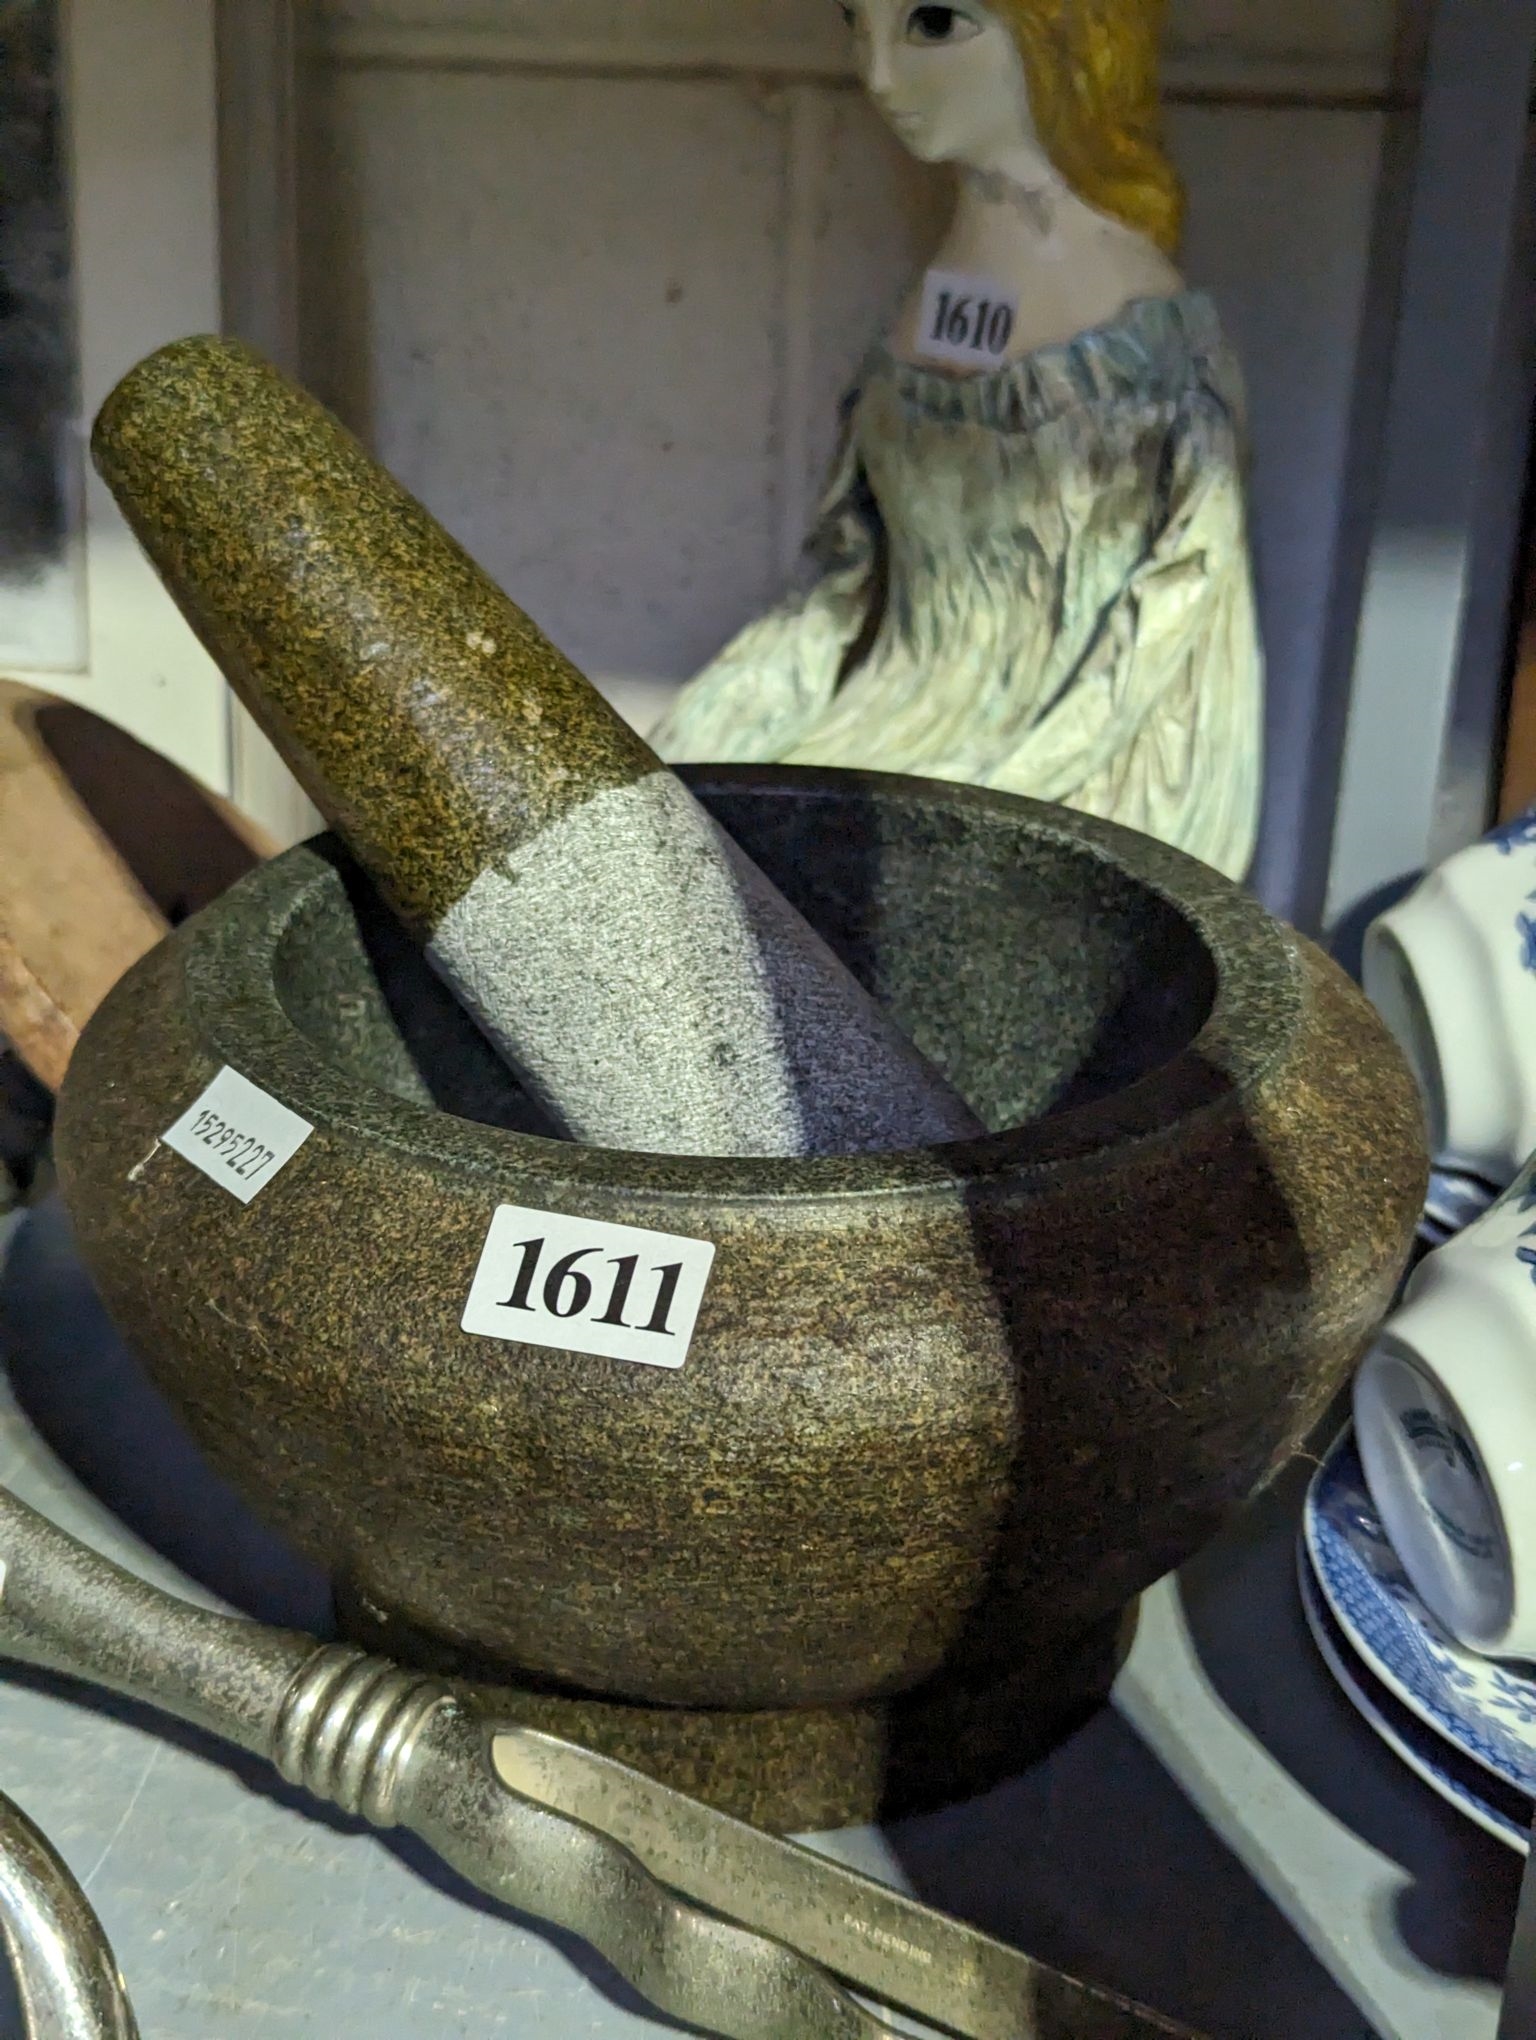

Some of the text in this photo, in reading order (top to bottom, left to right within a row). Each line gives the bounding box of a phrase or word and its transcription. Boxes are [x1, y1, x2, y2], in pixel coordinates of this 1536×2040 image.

[930, 289, 1012, 355] 1610
[190, 1109, 275, 1181] 15295227
[496, 1237, 683, 1336] 1611
